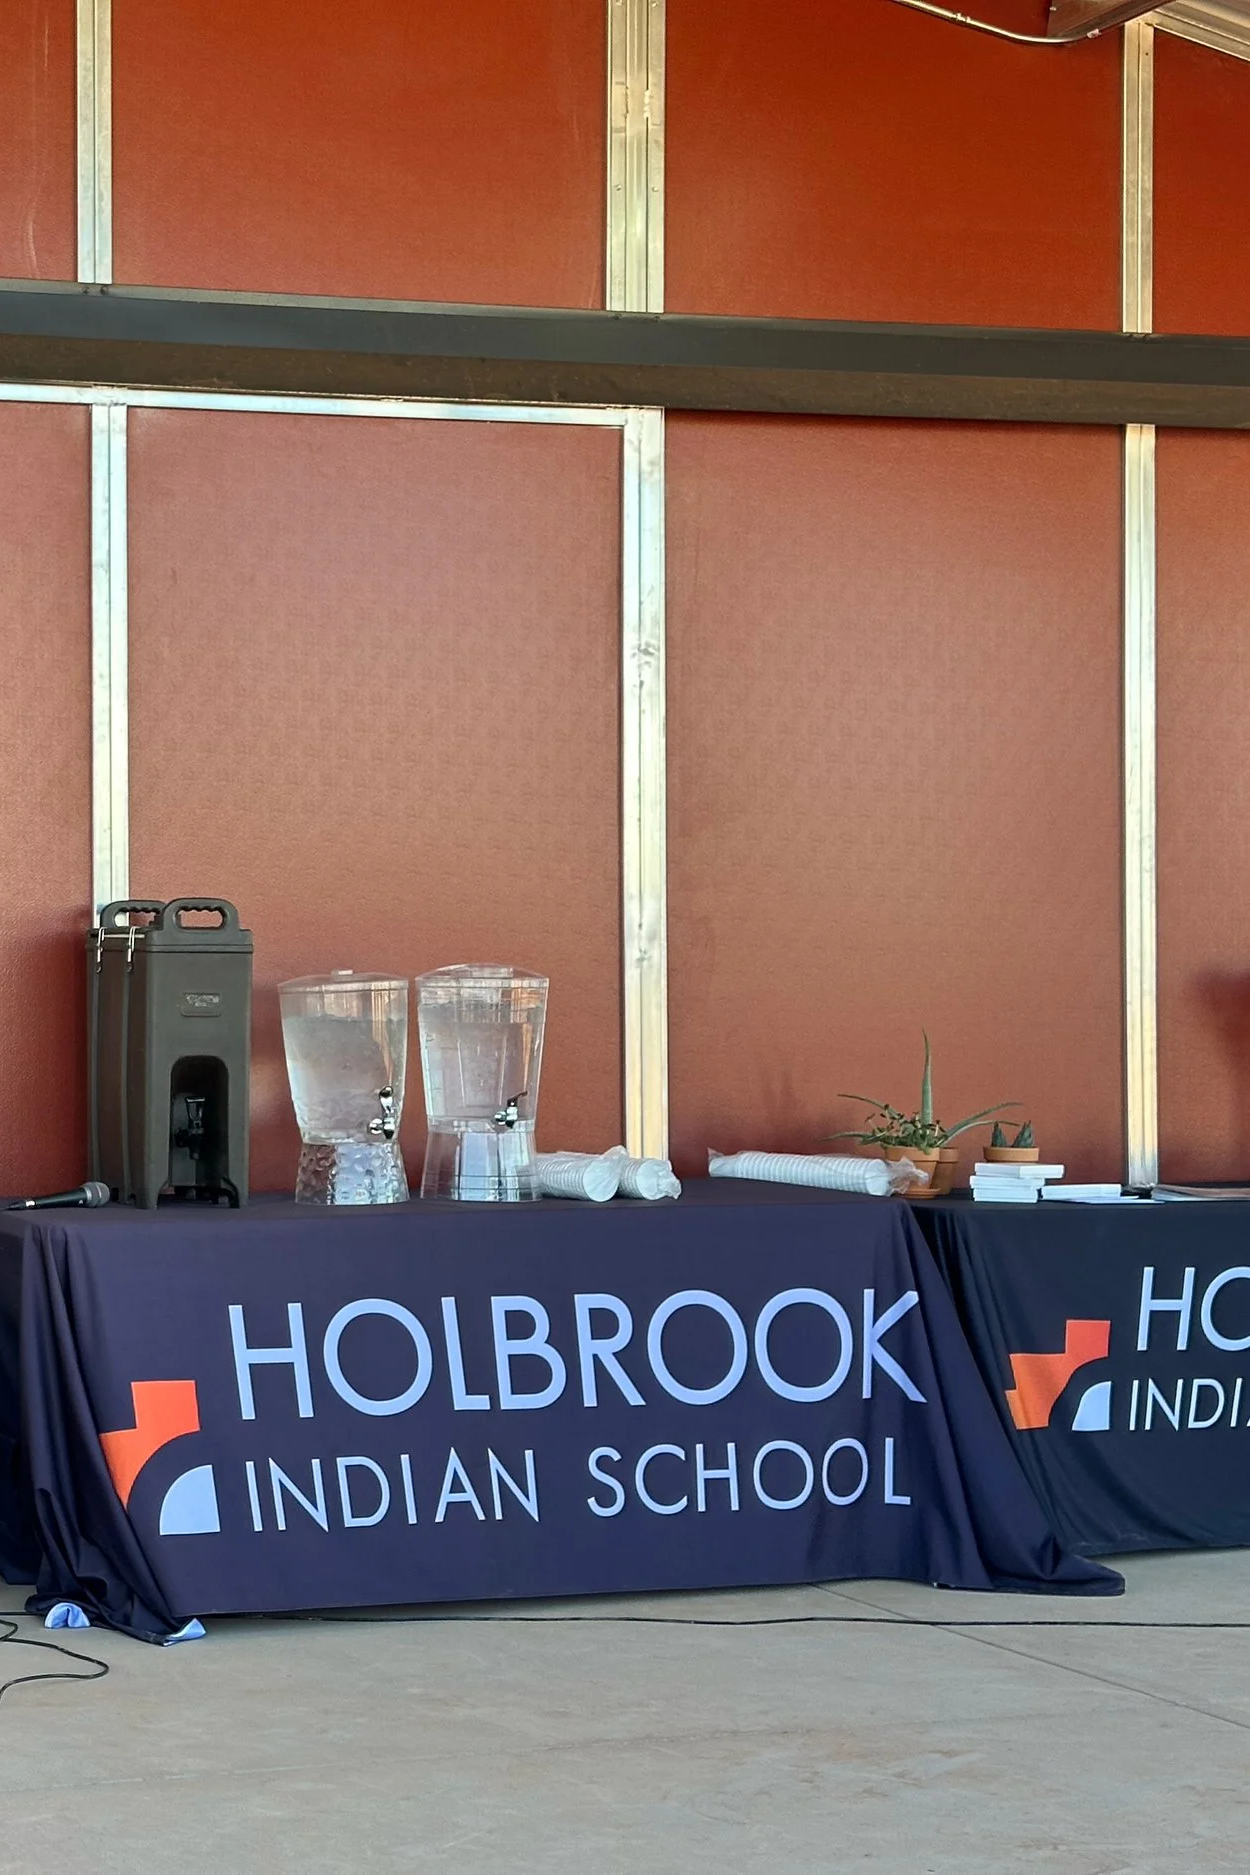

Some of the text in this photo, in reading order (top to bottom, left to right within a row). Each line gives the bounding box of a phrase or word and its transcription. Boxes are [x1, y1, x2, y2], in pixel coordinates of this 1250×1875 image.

[227, 1287, 928, 1421] HOLBROOK
[1136, 1265, 1250, 1352] HO
[1129, 1377, 1250, 1432] INDI
[245, 1436, 911, 1533] INDIAN SCHOOL
